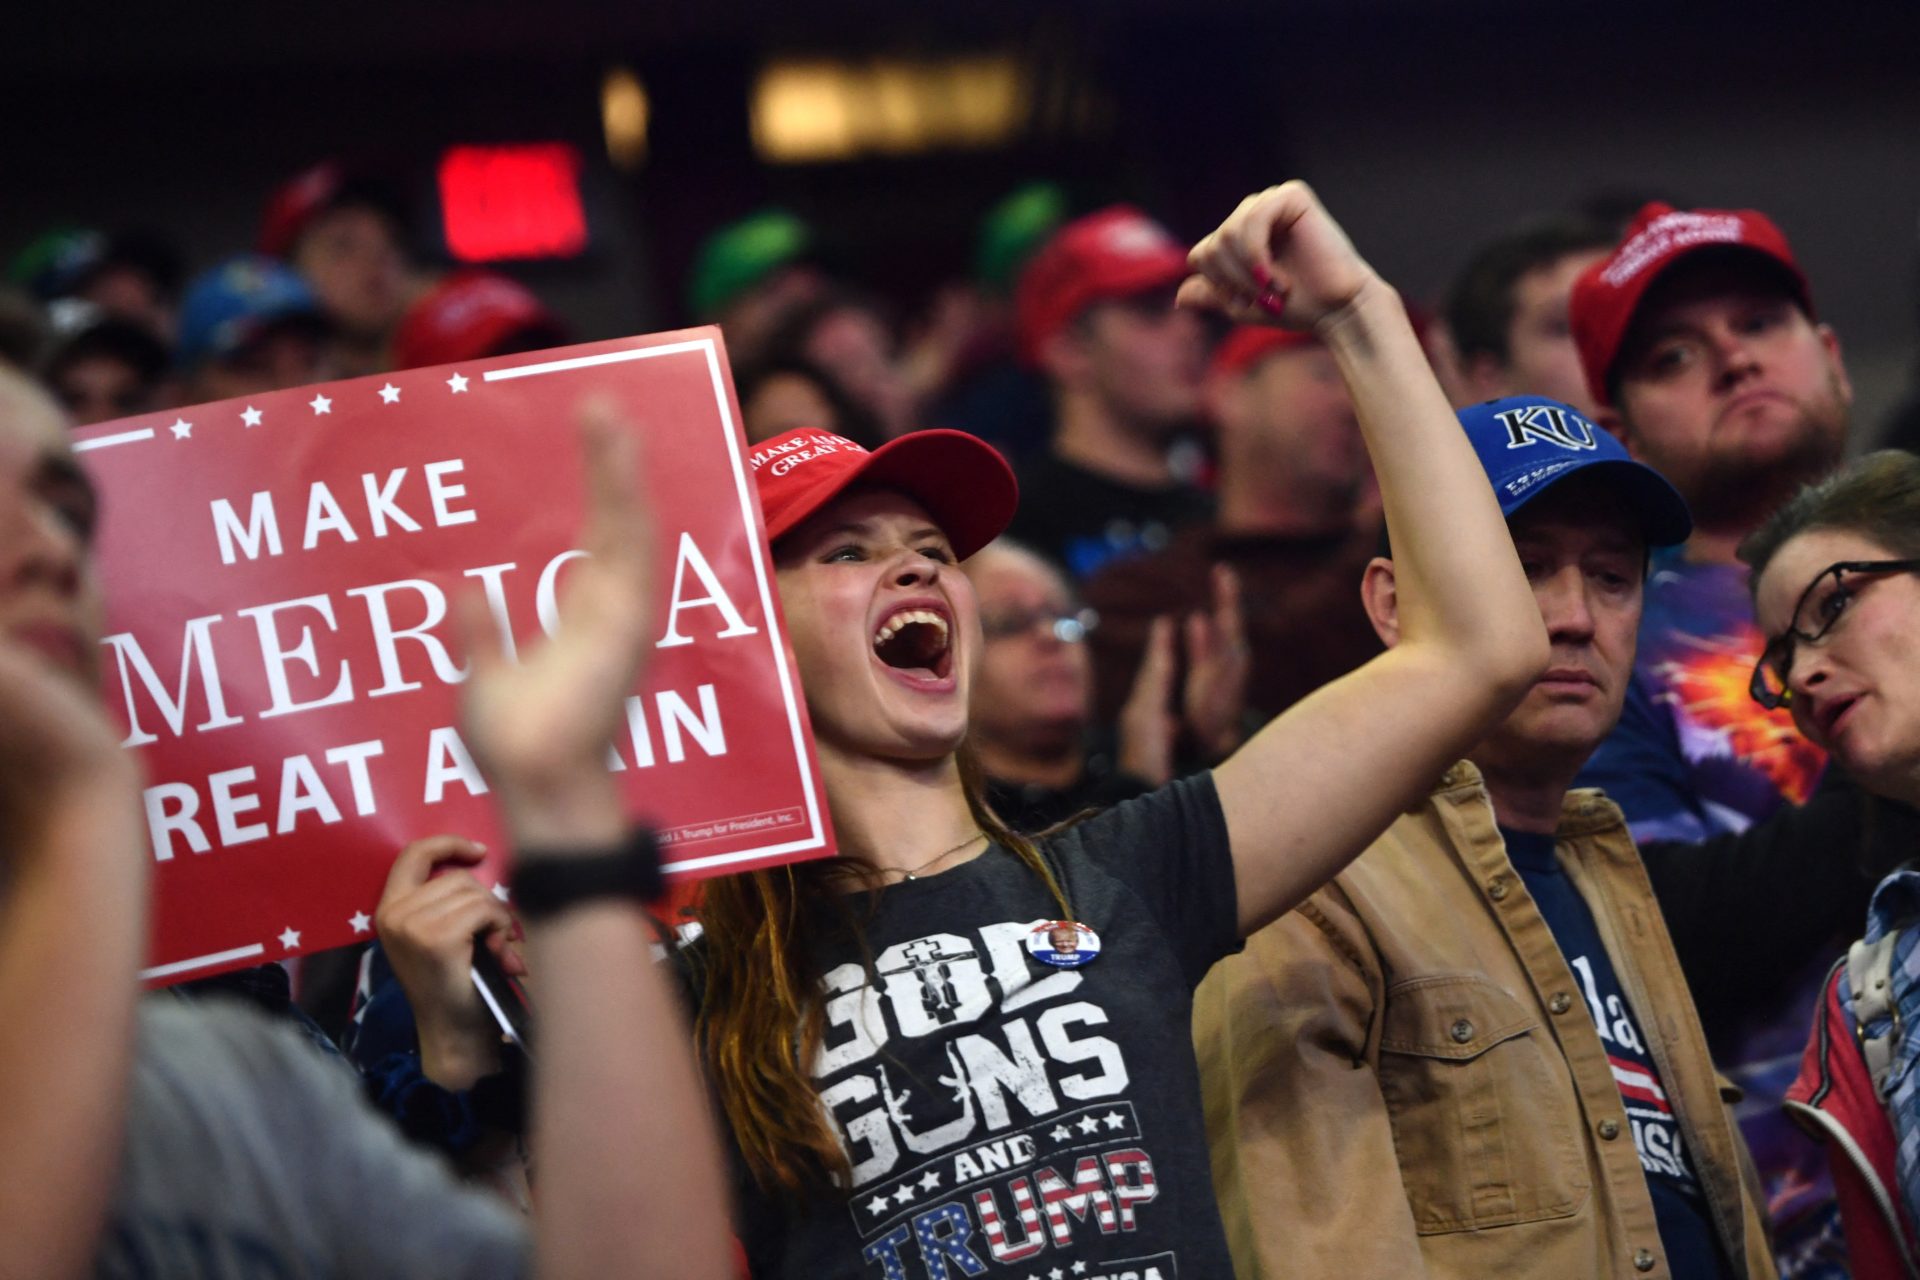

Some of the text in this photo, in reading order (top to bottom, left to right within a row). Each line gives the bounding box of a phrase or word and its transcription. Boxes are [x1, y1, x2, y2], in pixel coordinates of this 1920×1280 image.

[750, 437, 809, 471] MAKE
[771, 445, 839, 476] GREAT
[1494, 406, 1597, 451] KU
[210, 458, 477, 565] MAKE
[99, 531, 758, 749] MERICA
[143, 683, 728, 862] REAT AIN
[682, 827, 713, 840] Trump
[714, 823, 728, 835] for
[812, 919, 1084, 1079] GOD
[817, 1001, 1130, 1189] GUNS
[953, 1134, 1037, 1184] AND
[862, 1148, 1159, 1280] TRUMP
